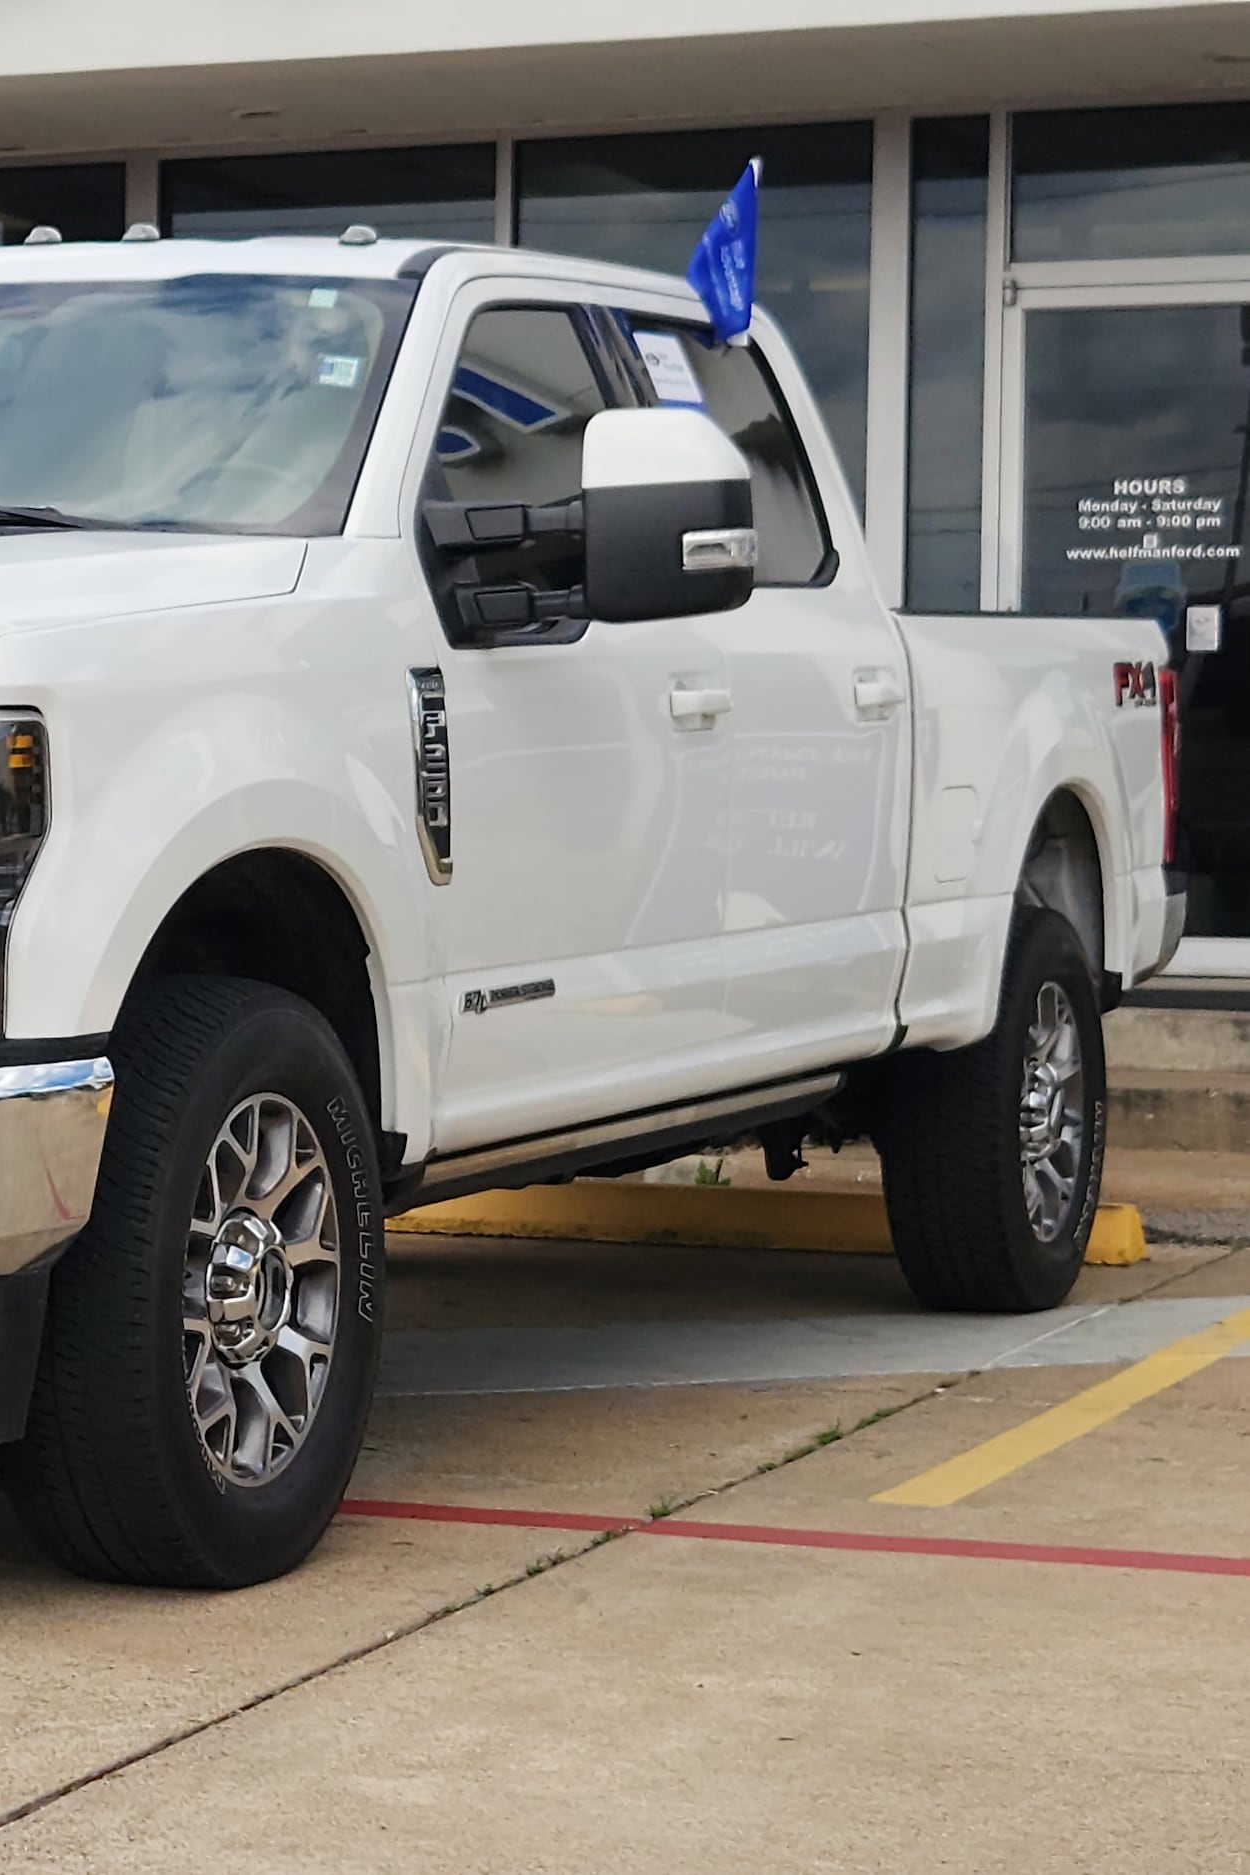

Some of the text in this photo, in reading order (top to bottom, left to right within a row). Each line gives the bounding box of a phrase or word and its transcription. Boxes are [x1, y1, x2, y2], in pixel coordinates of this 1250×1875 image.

[1113, 478, 1187, 496] HOURS
[1077, 498, 1139, 514] Monday
[1150, 497, 1223, 513] Saturday
[1077, 515, 1111, 530] 9:00
[1116, 517, 1142, 529] am
[1156, 514, 1192, 529] 9:00
[1195, 516, 1222, 530] pm
[1065, 544, 1241, 561] www.helfmanford.com
[326, 1094, 375, 1323] MICHELIN
